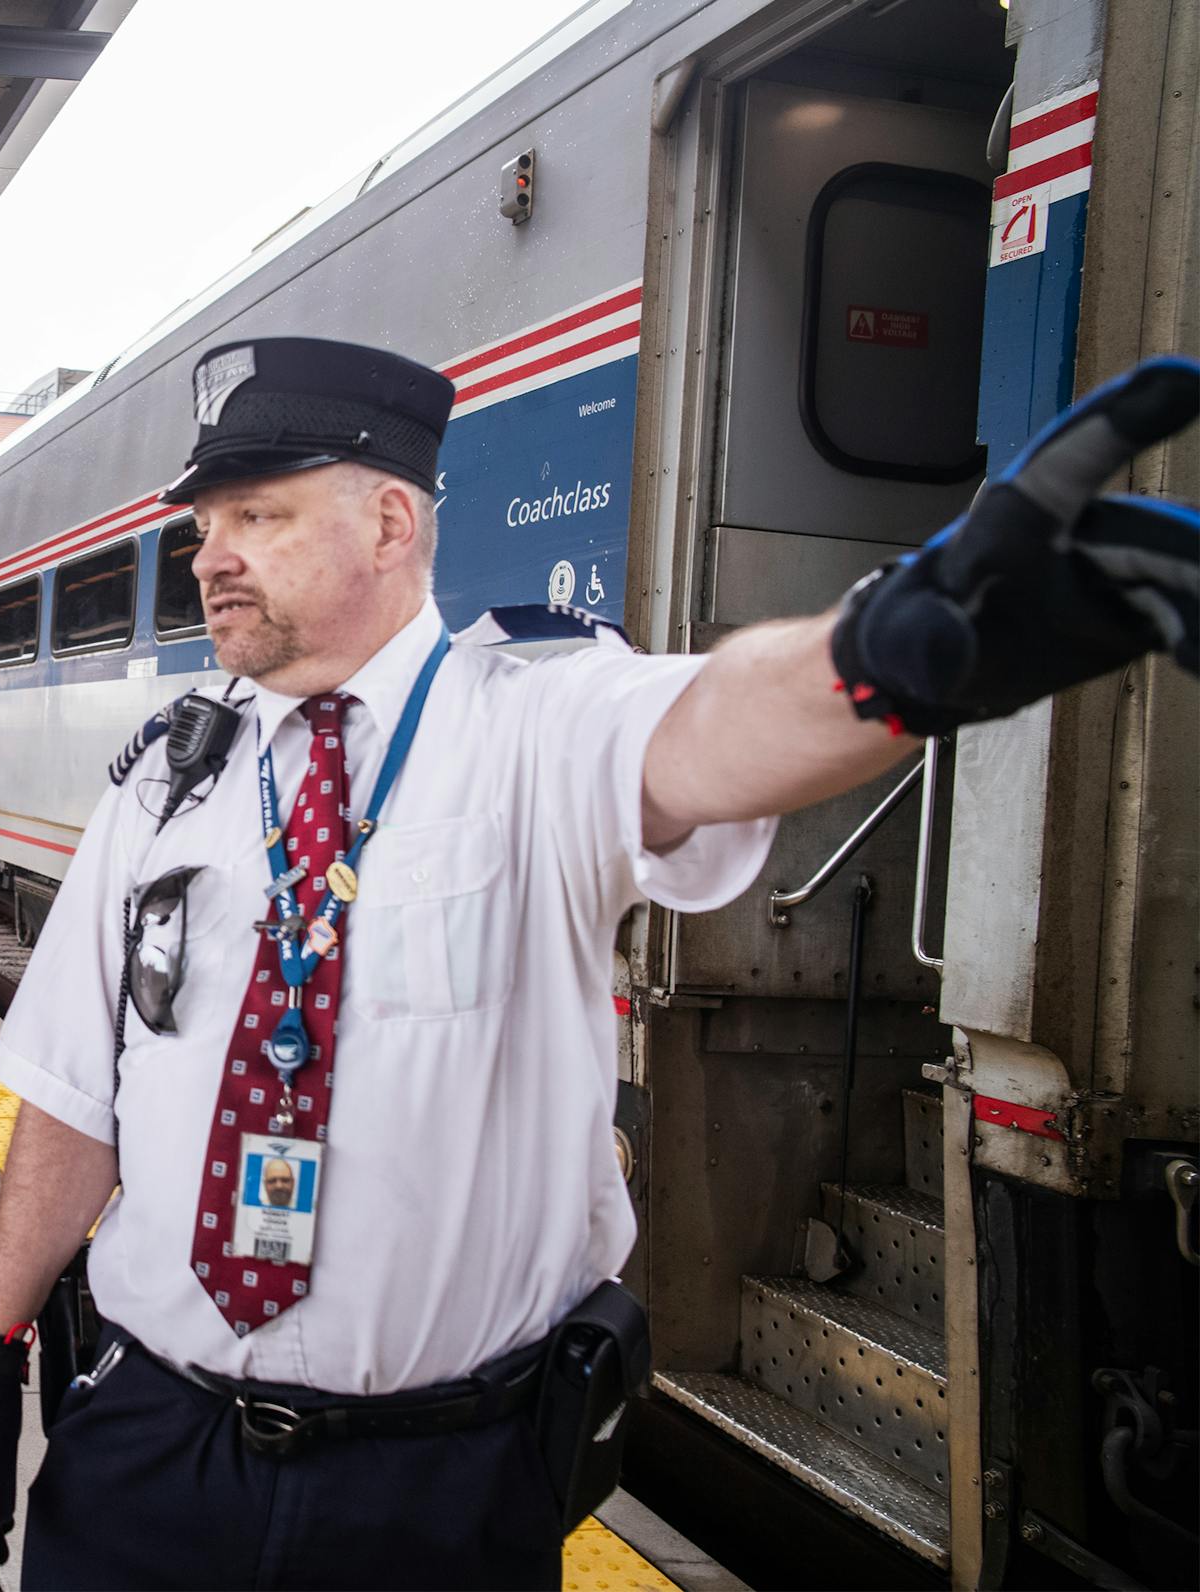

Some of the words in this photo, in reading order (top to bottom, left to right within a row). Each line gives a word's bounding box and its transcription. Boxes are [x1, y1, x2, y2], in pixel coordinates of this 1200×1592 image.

[1011, 194, 1033, 207] OPEN
[999, 245, 1034, 262] SECURED
[578, 398, 616, 418] Welcome
[507, 481, 611, 527] Coachclass
